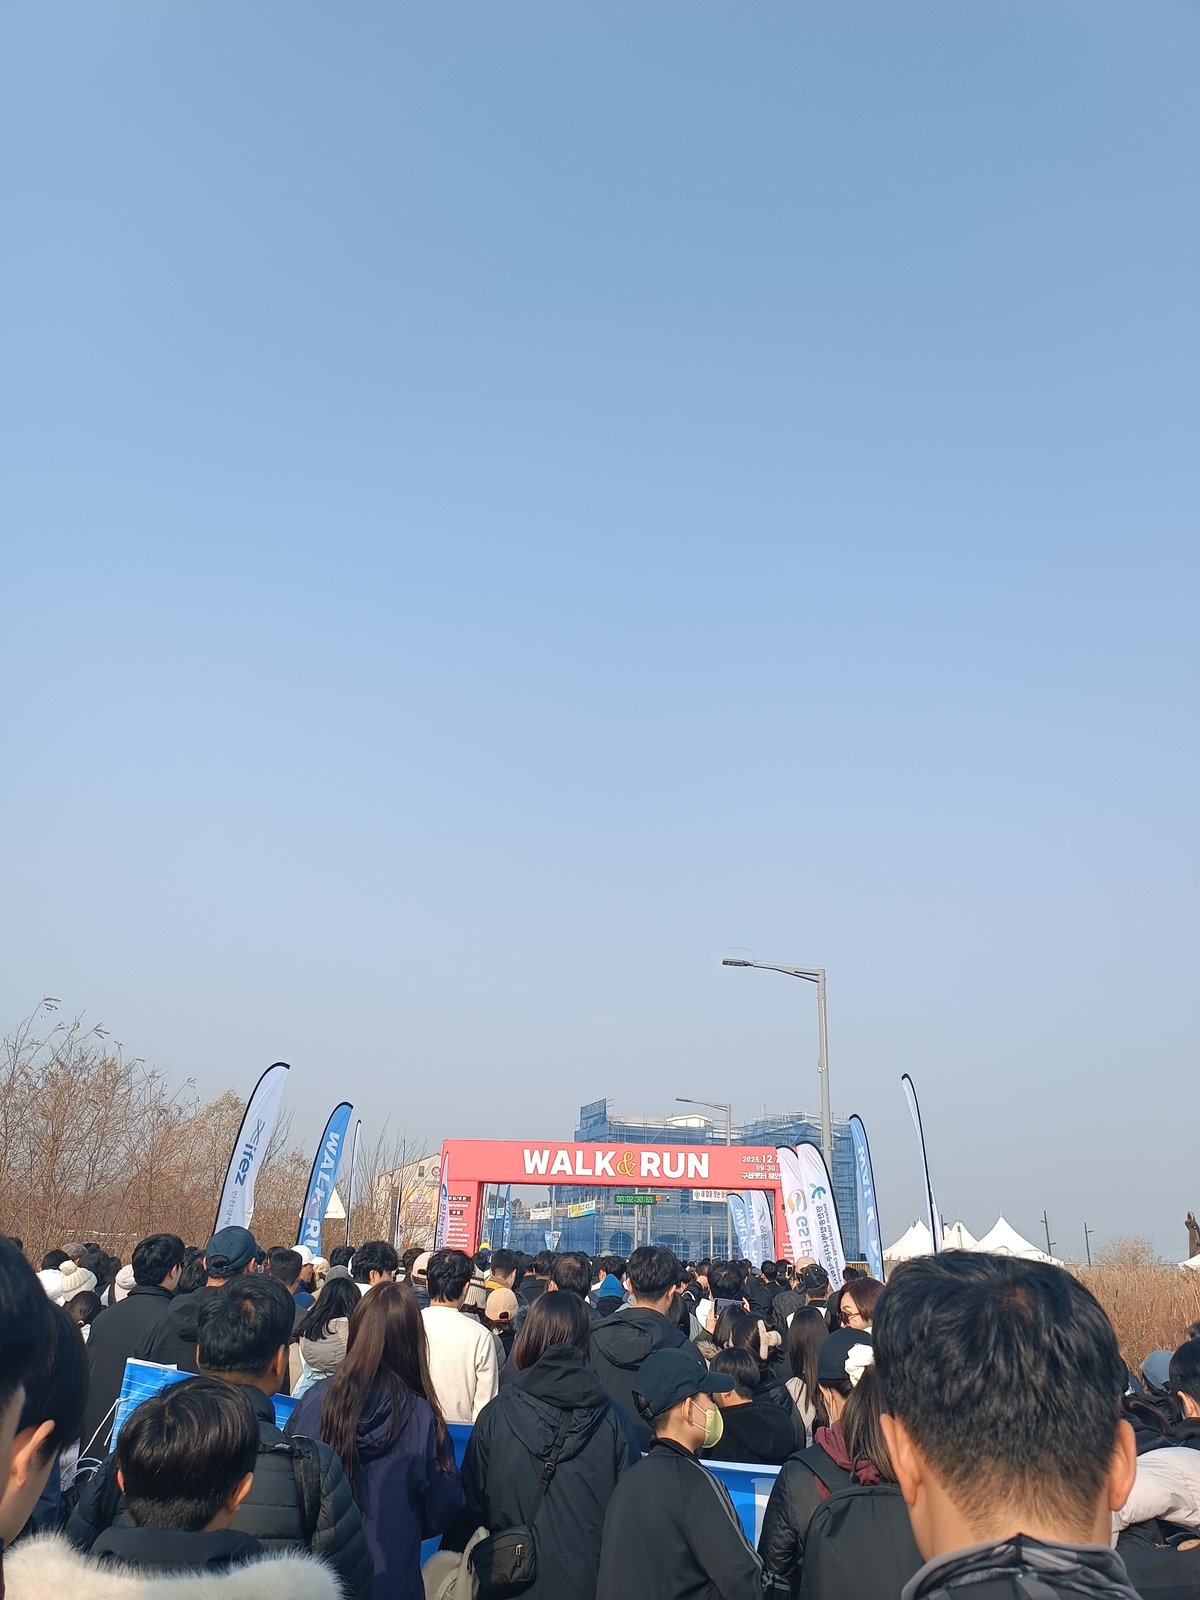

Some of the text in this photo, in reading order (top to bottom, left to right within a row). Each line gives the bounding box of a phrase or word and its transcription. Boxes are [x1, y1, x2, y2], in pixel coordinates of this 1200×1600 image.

[235, 1143, 256, 1187] ifez
[311, 1131, 340, 1206] WALK
[755, 1164, 776, 1172] 09:30
